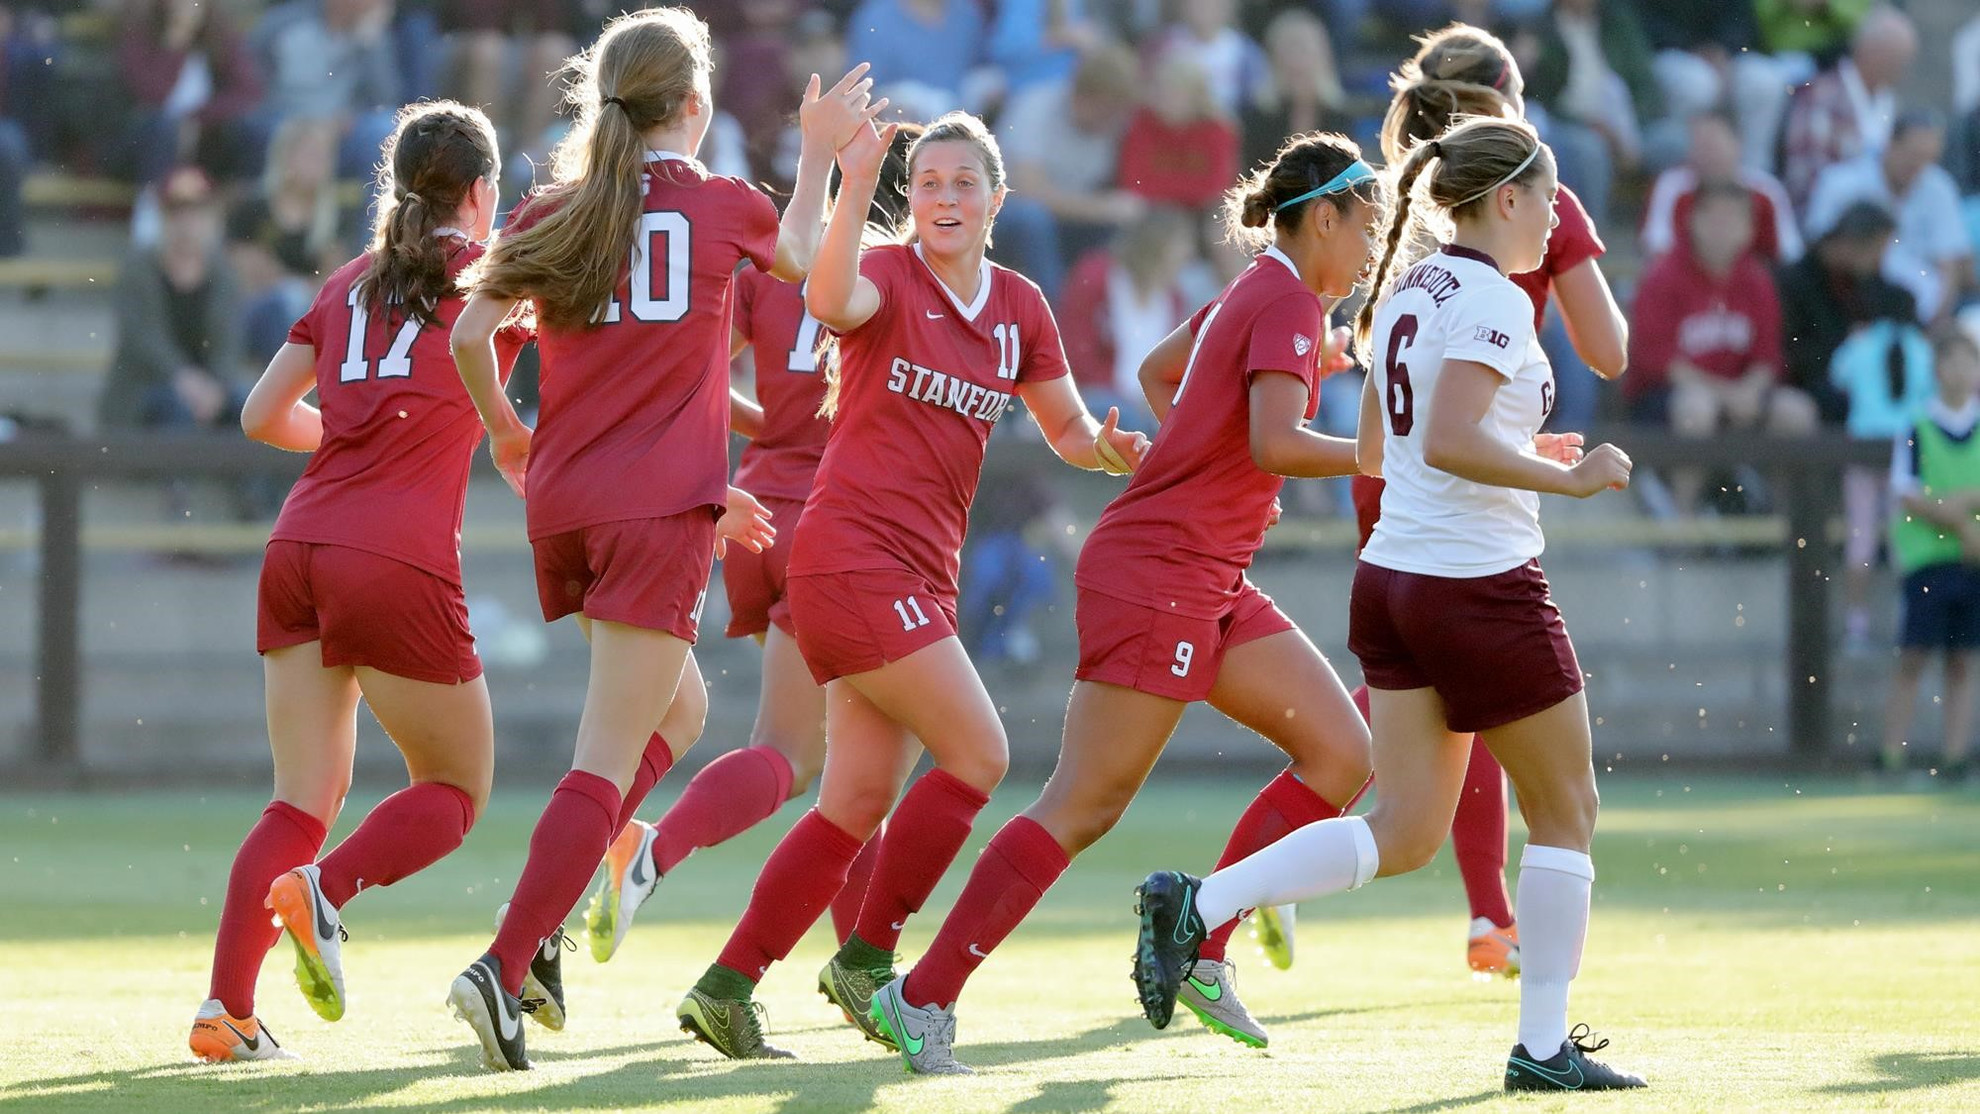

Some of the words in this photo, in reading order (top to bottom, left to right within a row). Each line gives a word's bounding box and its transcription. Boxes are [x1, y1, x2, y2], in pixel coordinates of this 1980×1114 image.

[589, 210, 692, 324] 0
[993, 322, 1020, 380] 11
[1386, 314, 1418, 436] 6
[887, 356, 1012, 423] STANFOR
[893, 594, 931, 632] 11
[1170, 640, 1194, 678] 9
